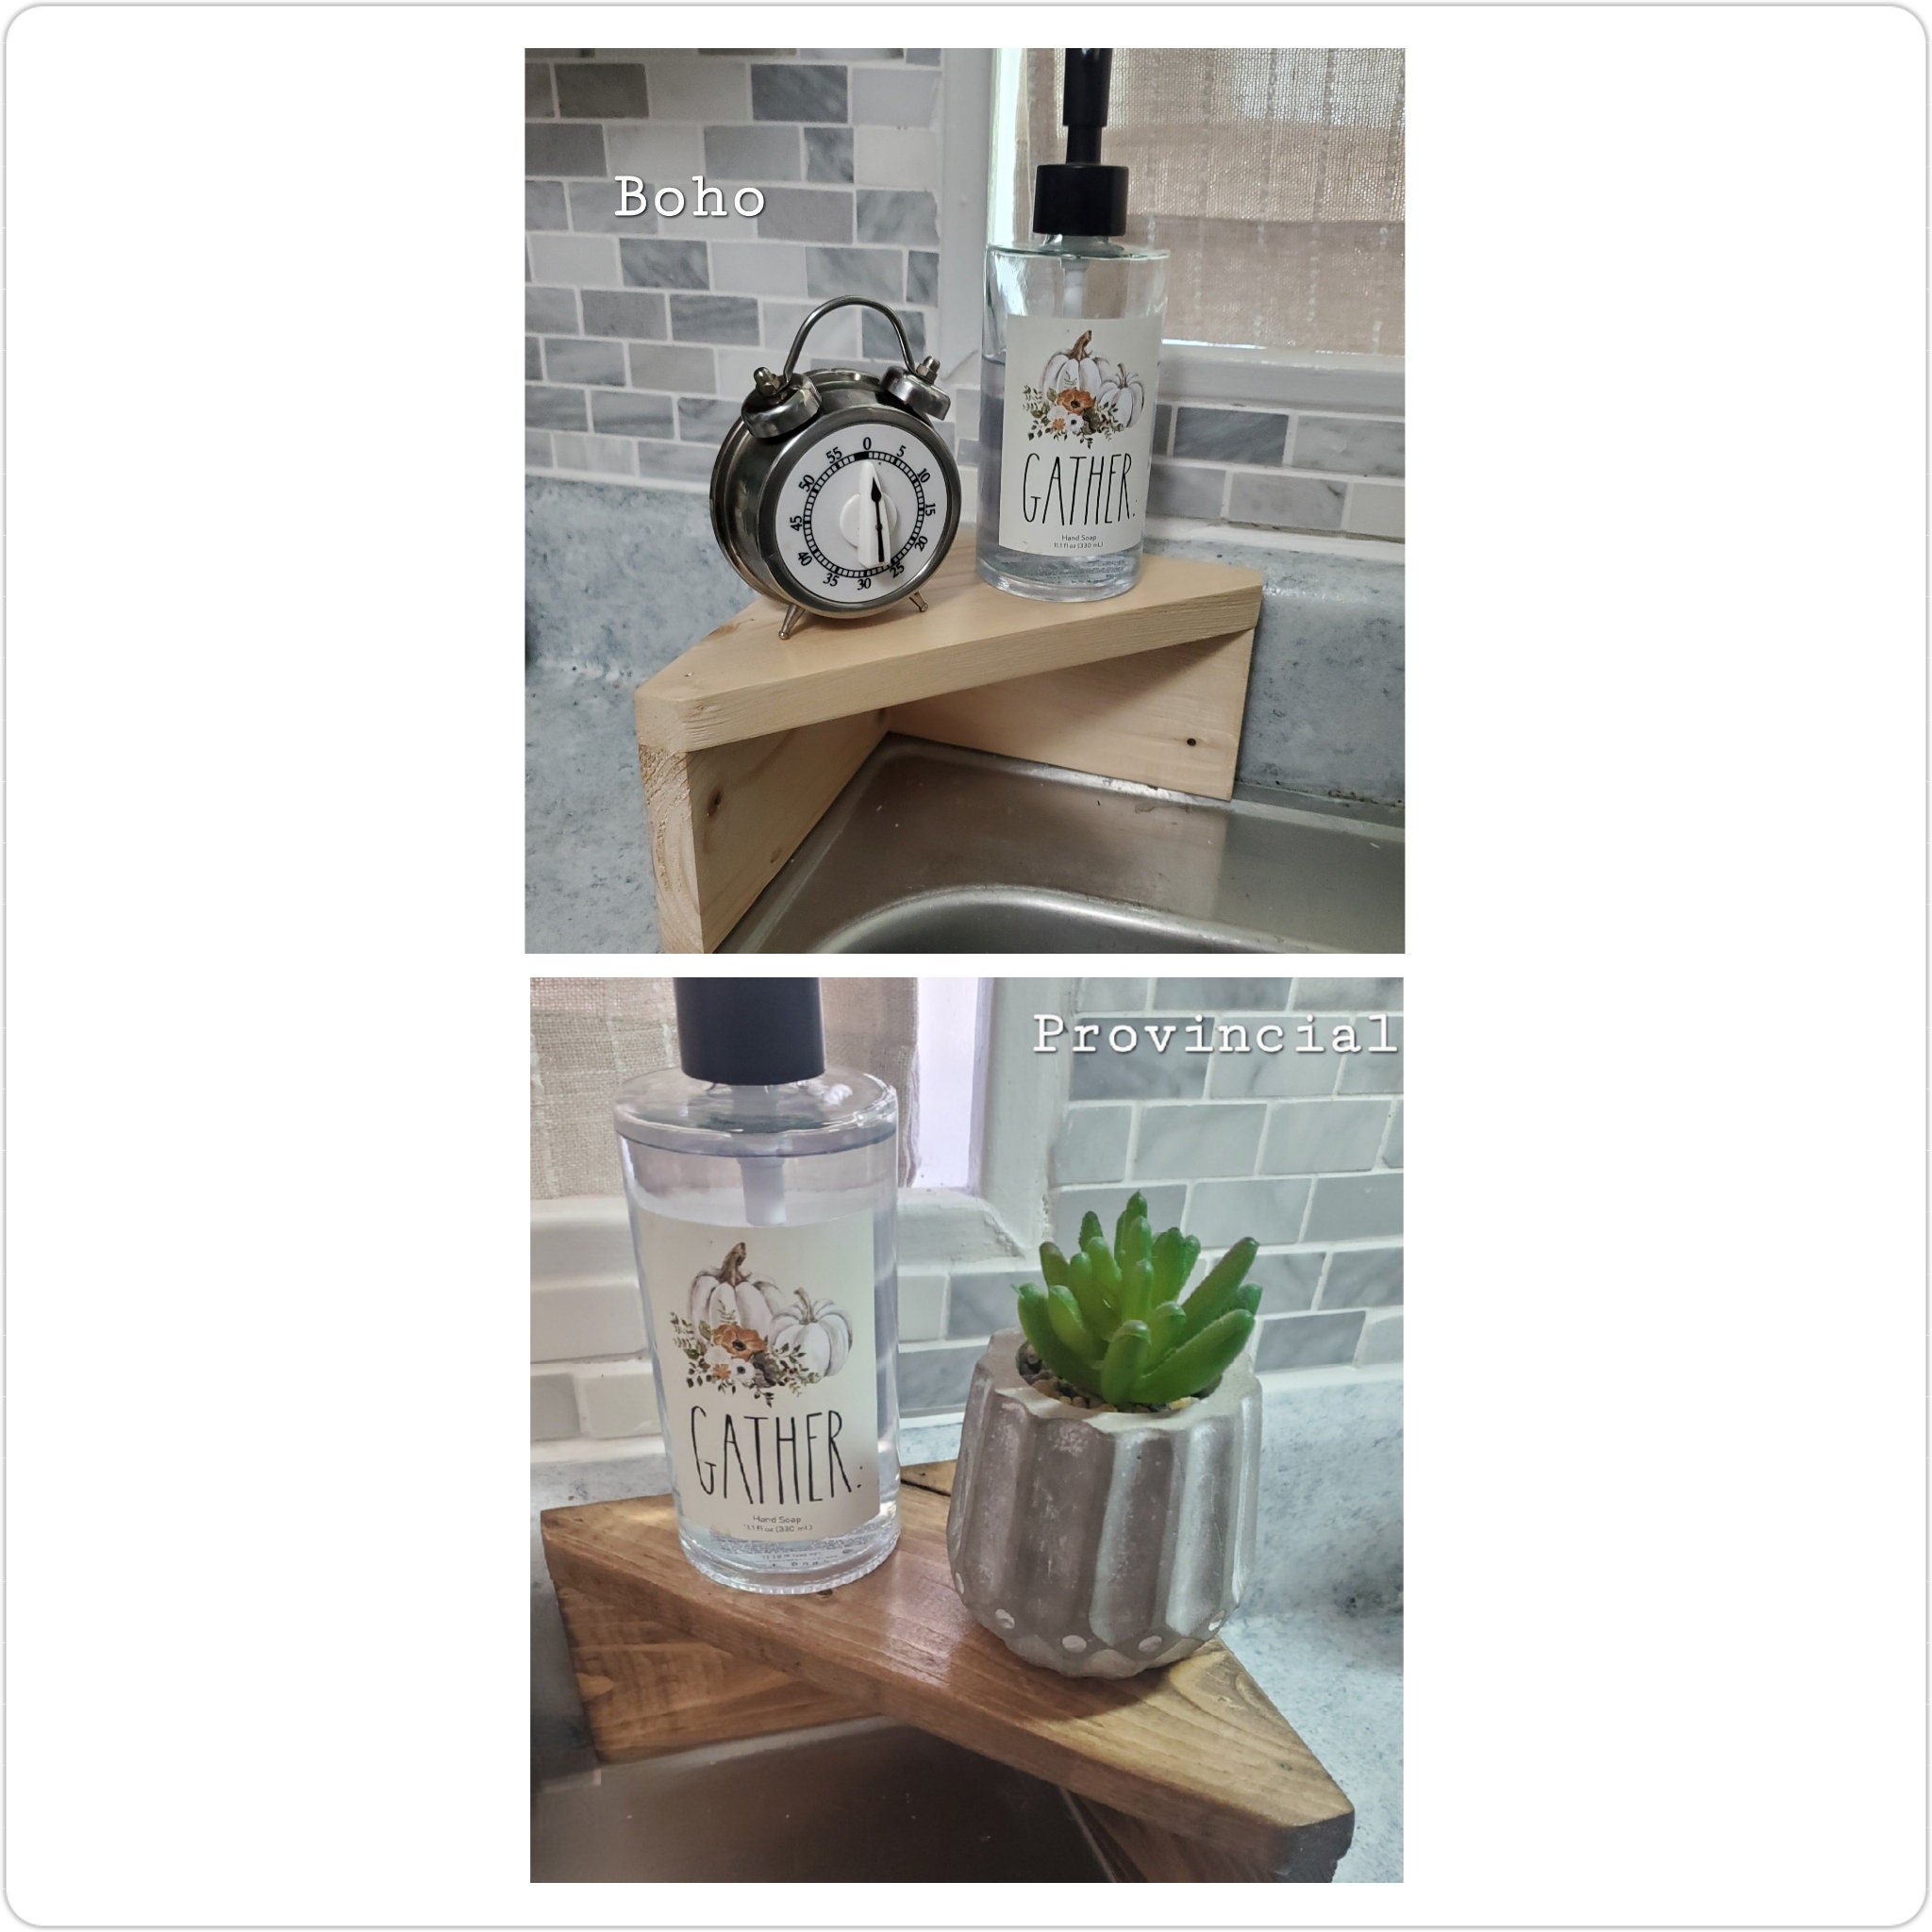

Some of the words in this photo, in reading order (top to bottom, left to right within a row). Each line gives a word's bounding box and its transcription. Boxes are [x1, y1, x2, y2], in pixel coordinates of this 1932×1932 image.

[862, 437, 873, 450] 0
[825, 446, 843, 464] 55
[896, 445, 907, 458] 5
[917, 468, 931, 484] 10
[798, 475, 815, 492] 50
[924, 503, 937, 517] 15
[790, 515, 803, 532] 45
[914, 536, 928, 552] 20
[1081, 534, 1097, 542] Soap
[797, 552, 813, 566] 40
[890, 563, 905, 578] 25
[823, 573, 840, 587] 35
[857, 578, 872, 591] 30
[753, 1515, 777, 1524] Hand
[778, 1515, 802, 1524] Soap
